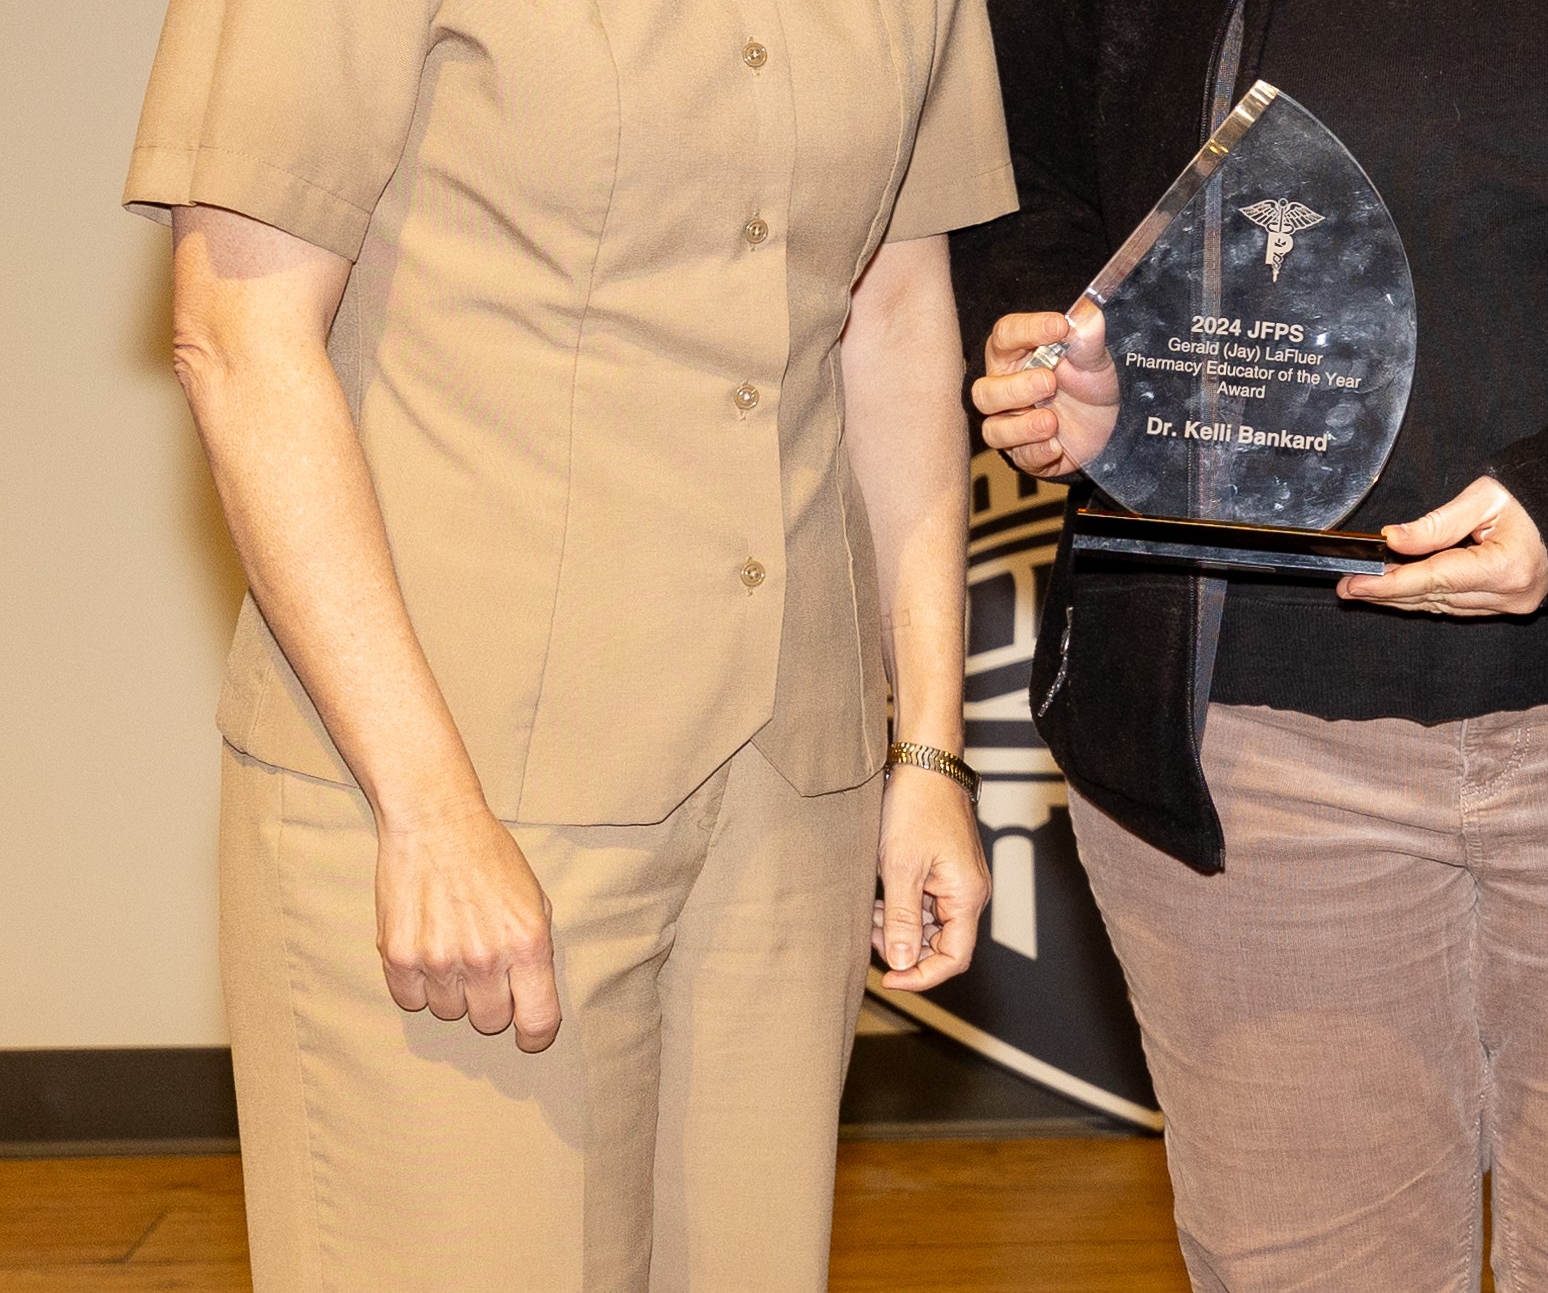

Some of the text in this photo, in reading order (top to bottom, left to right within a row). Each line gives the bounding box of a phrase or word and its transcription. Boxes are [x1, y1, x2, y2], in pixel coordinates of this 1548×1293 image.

[1190, 315, 1305, 343] 2024 JFPS
[1168, 337, 1324, 366] Gerald (Jay) LaFluer
[1125, 352, 1362, 389] Pharmacy Educator of the Year
[1216, 380, 1266, 399] Award
[1146, 416, 1328, 452] Dr. Kelli Bankard
